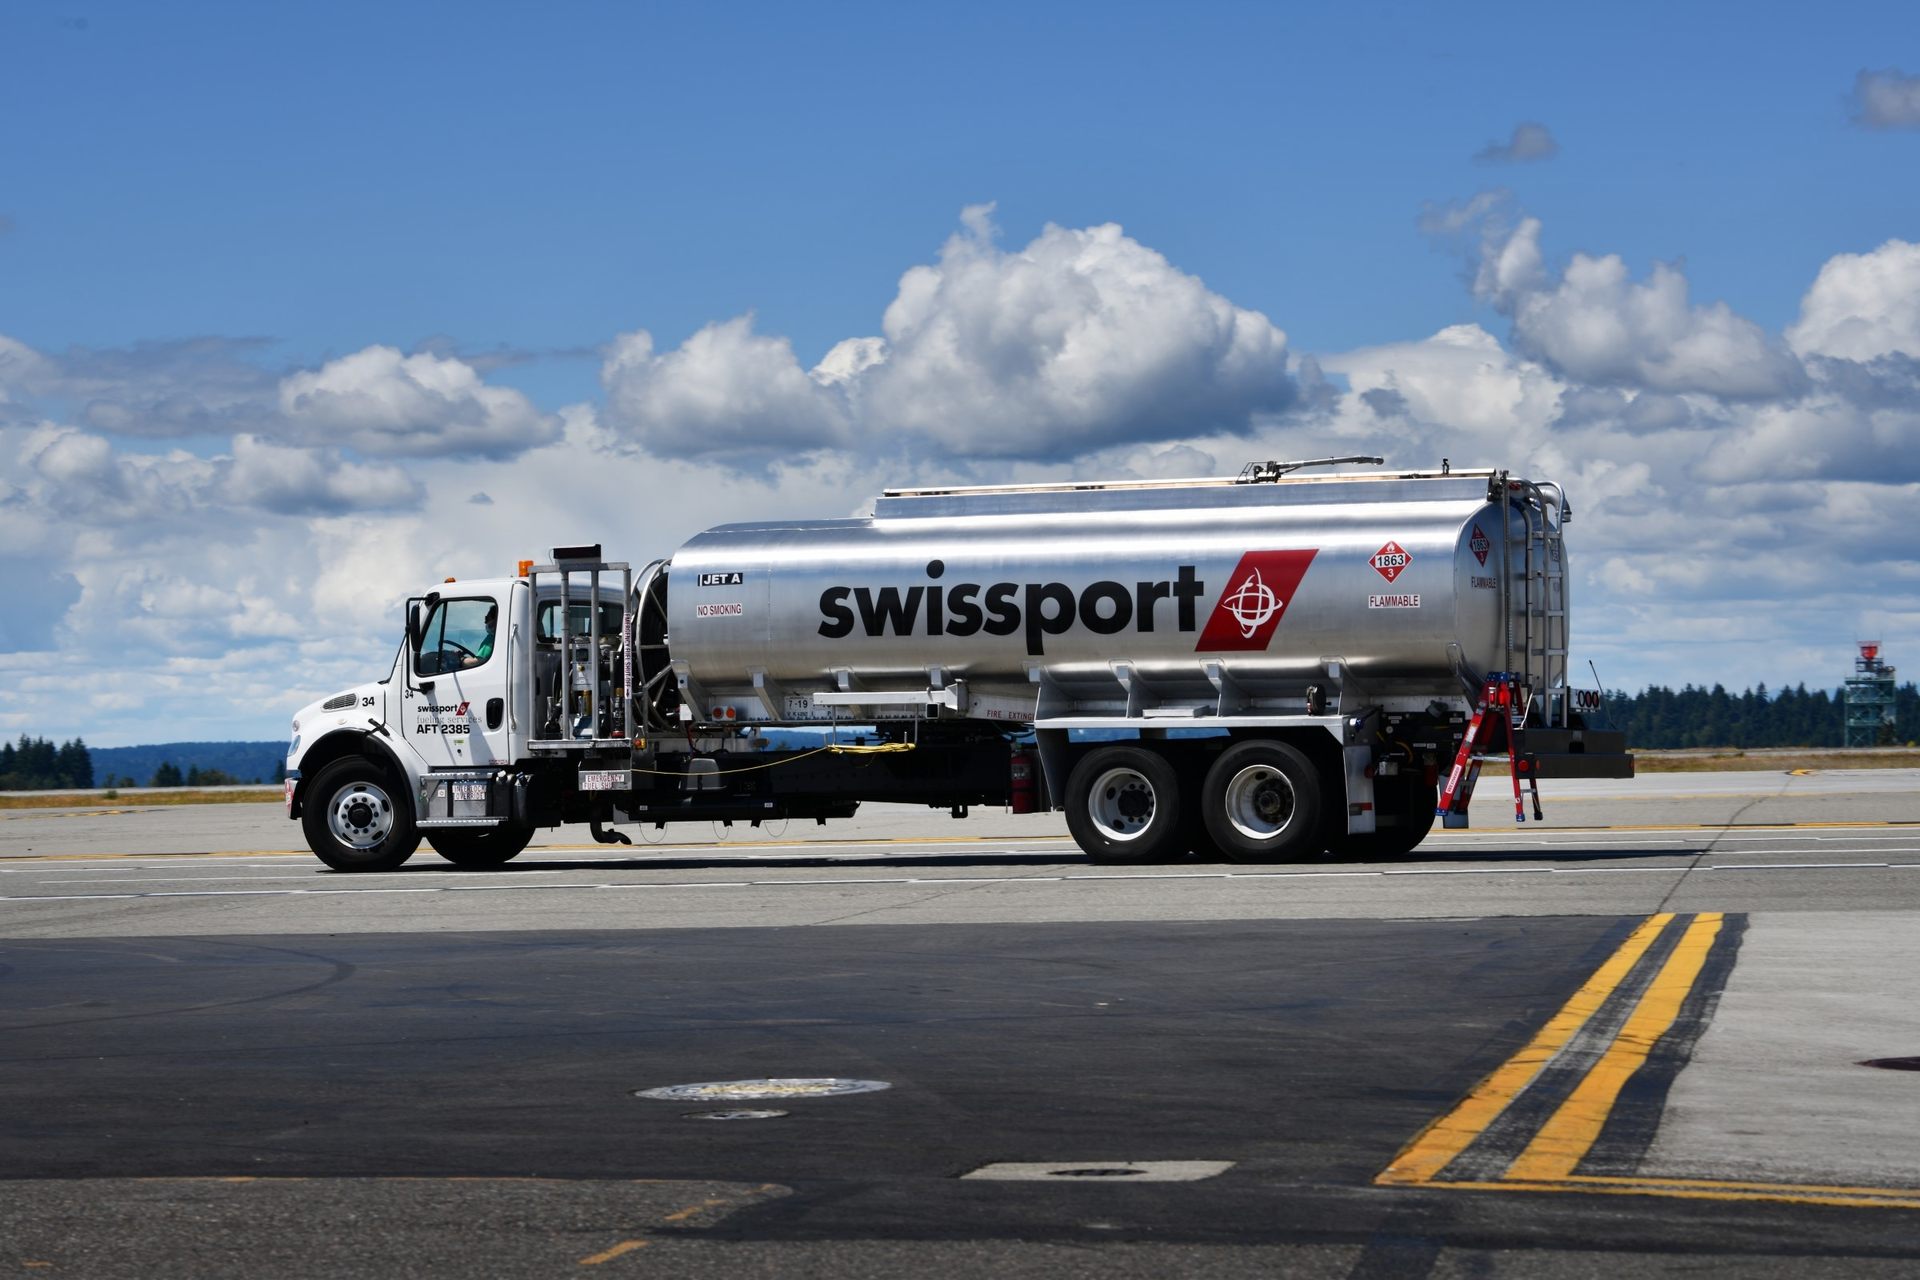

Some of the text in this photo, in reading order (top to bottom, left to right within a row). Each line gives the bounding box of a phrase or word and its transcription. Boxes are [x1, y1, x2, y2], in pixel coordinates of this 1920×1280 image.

[1473, 540, 1487, 551] 1863
[1377, 554, 1404, 566] 1863
[1387, 568, 1394, 578] 3
[703, 573, 741, 585] JET A
[1471, 576, 1497, 589] FLAMMABLE
[1369, 595, 1419, 607] FLAMMABLE
[698, 603, 742, 616] NO SMOKING
[817, 559, 1204, 655] swissport
[404, 690, 414, 699] 34
[362, 696, 375, 707] 34
[417, 703, 458, 714] swissport
[986, 709, 1002, 718] FIRE
[416, 715, 483, 725] fueling services
[416, 724, 470, 734] AFT 2385
[587, 774, 622, 782] EMERGENCY
[453, 785, 486, 793] INTERLOCK
